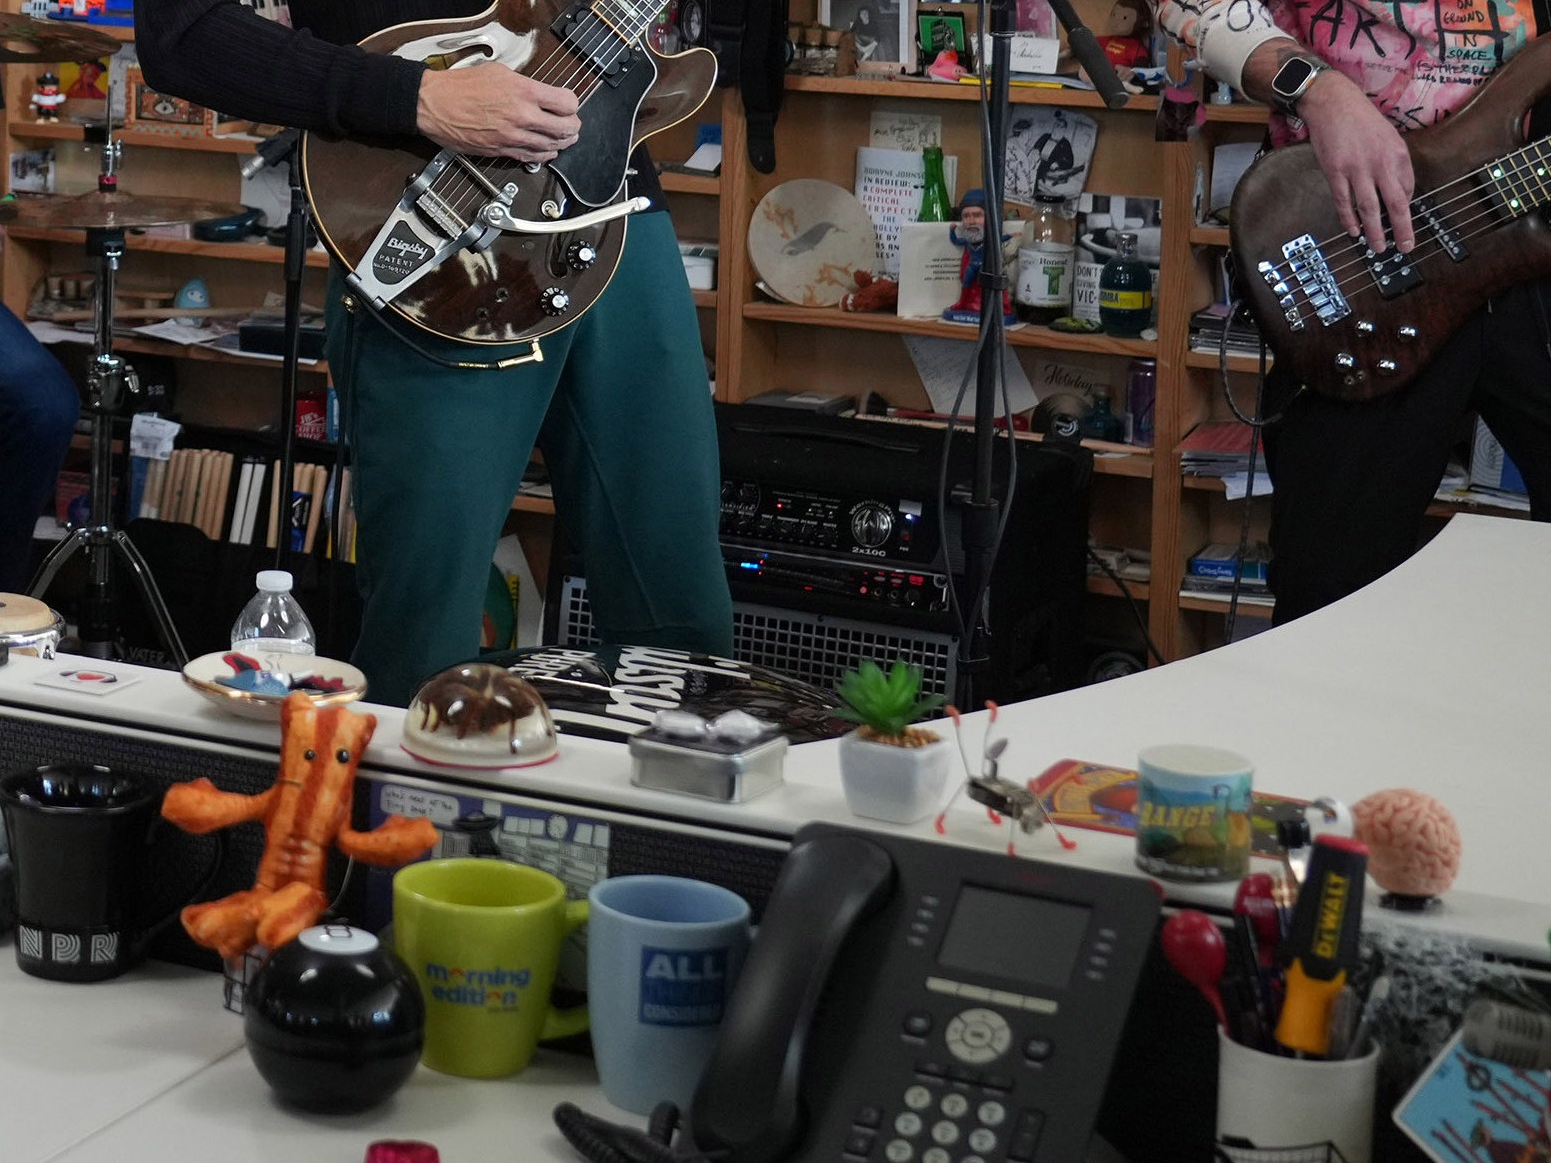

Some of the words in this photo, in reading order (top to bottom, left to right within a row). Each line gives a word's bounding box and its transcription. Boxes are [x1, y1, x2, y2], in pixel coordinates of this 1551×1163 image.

[1447, 48, 1491, 61] SPACE
[863, 195, 899, 204] CRITICAL
[870, 187, 912, 197] COMPLETE
[387, 237, 428, 259] Bigsby
[379, 254, 413, 267] PATENT
[1039, 257, 1068, 266] Honest
[1077, 266, 1097, 277] DON'T
[129, 647, 166, 665] VATER
[1315, 871, 1349, 959] DEWALT
[19, 923, 121, 964] NPR
[425, 961, 532, 988] morning
[644, 953, 725, 981] ALL
[432, 984, 518, 1007] edition
